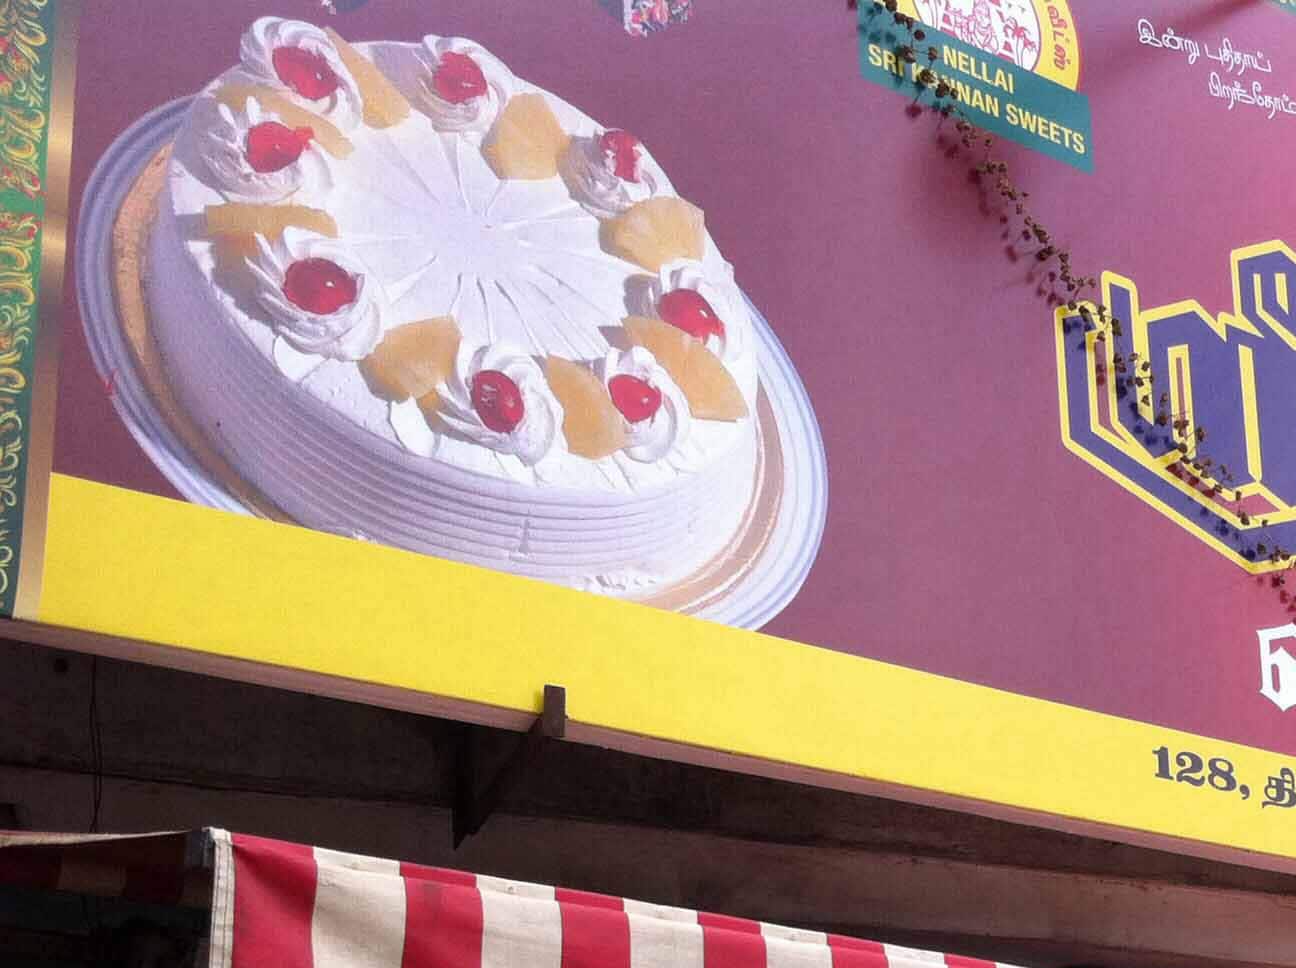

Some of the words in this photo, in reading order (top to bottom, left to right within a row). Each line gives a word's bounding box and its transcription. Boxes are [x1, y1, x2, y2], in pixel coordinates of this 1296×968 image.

[942, 45, 1016, 94] NELLAI
[1137, 18, 1201, 65] இன்று
[1205, 38, 1272, 76] புதிதாய்
[868, 43, 905, 76] SRI
[1005, 103, 1086, 154] SWEETS
[1152, 745, 1251, 801] 128,
